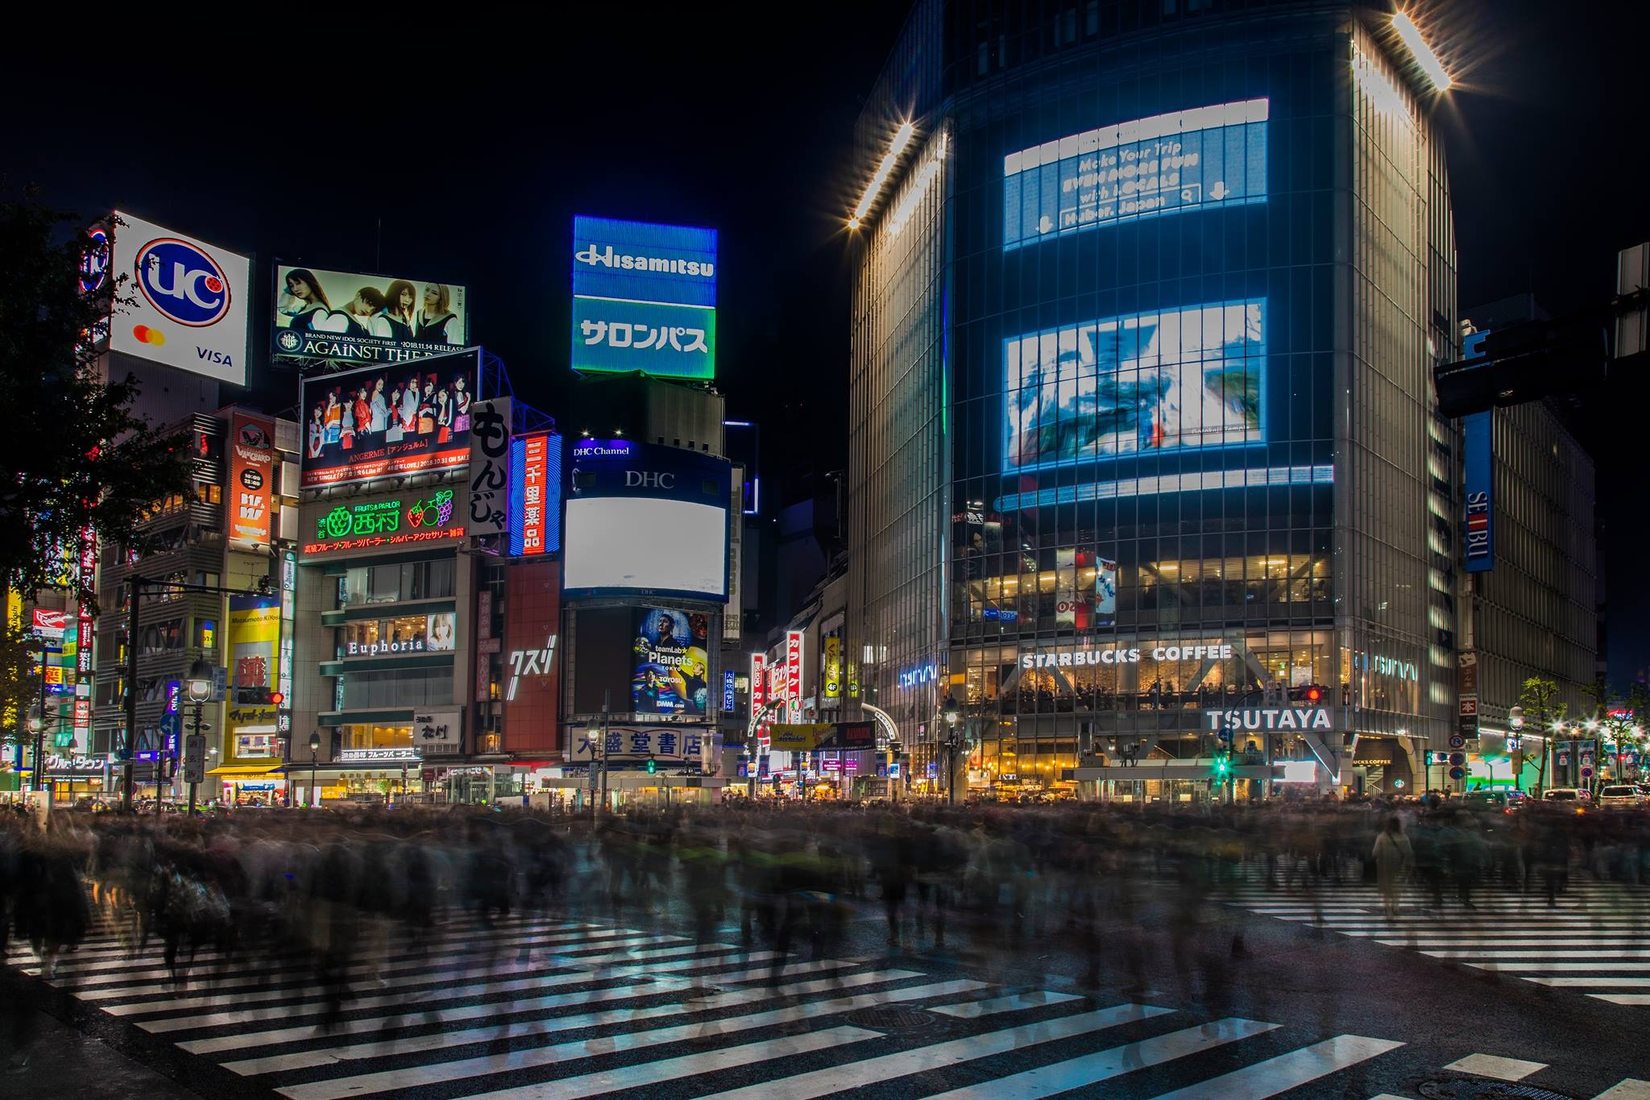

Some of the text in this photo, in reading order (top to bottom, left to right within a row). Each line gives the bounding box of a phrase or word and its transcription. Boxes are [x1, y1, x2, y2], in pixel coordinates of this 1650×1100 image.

[1078, 141, 1182, 173] Make Your Trip
[1062, 152, 1199, 193] EVEN MORE FUN
[1080, 172, 1180, 204] with LOCALS
[1118, 196, 1165, 216] Japan
[575, 244, 714, 277] Hisamitsu
[342, 335, 356, 343] IDOL
[356, 337, 382, 345] SOCIETY
[382, 339, 397, 347] FIRST
[580, 319, 708, 354] サロンパス
[196, 346, 233, 368] VISA
[574, 446, 630, 456] DHC Channel
[469, 401, 509, 532] もんじゃ
[624, 470, 675, 490] DHC
[524, 441, 543, 548] 三千里薬品
[353, 510, 400, 535] 西村
[1468, 490, 1488, 558] SEIBU
[348, 639, 423, 656] Euphoria
[648, 651, 693, 667] Planets
[655, 645, 682, 654] teamLab
[1022, 644, 1232, 669] STARBUCKS COFFEE
[788, 638, 800, 687] カラオケ
[1462, 701, 1475, 712] 本
[1206, 708, 1331, 730] TSUTAYA
[577, 732, 701, 755] 大盛堂書店
